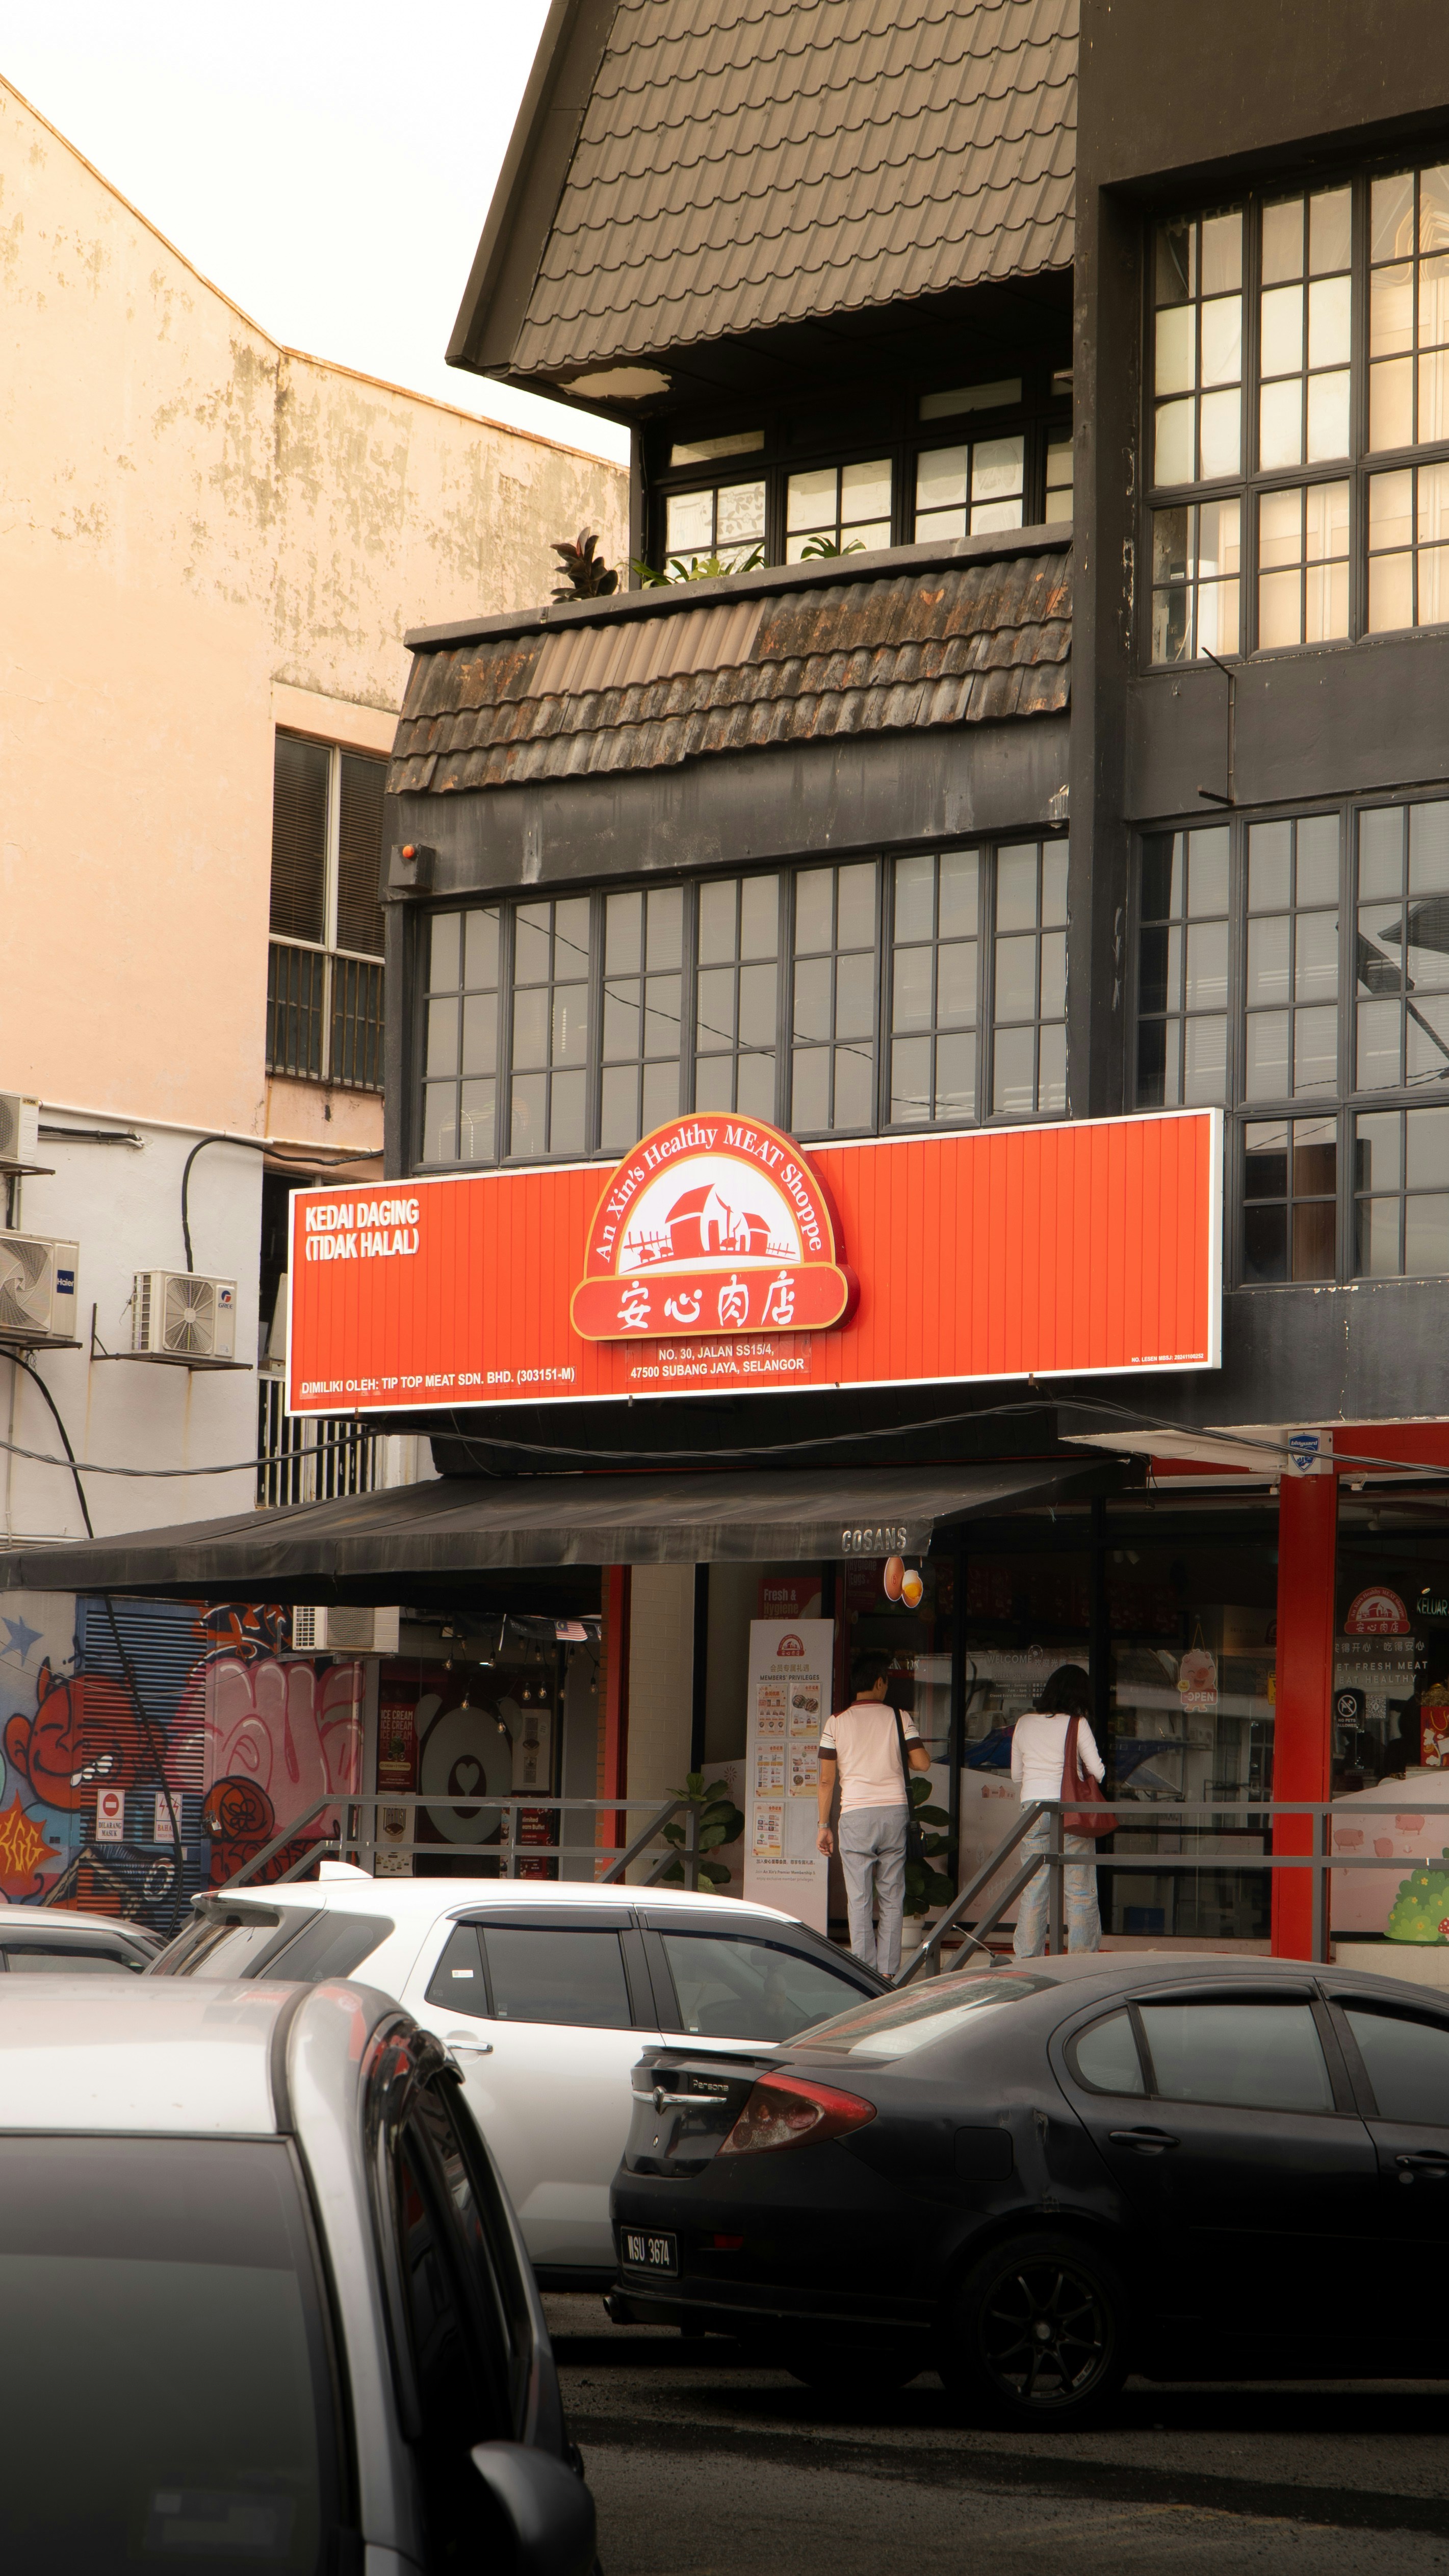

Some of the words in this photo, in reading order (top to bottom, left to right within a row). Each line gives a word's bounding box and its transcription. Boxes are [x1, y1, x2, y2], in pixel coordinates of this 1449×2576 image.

[596, 1225, 616, 1263] An
[607, 1166, 645, 1220] Xin's
[642, 1124, 718, 1170] Healthy
[723, 1125, 785, 1168] MEAT
[780, 1163, 822, 1251] Shoppe
[306, 1204, 354, 1232] KEDAI
[357, 1198, 420, 1228] DAGING
[306, 1233, 358, 1261] (TIDAK
[360, 1228, 420, 1258] HALAL)
[57, 1278, 74, 1287] Haier
[617, 1270, 795, 1331] 安心肉店
[659, 1349, 678, 1361] NO.
[680, 1347, 695, 1360] 30,
[697, 1345, 733, 1359] JALAN
[736, 1343, 774, 1357] SS15/4,
[631, 1366, 659, 1379] 47500
[662, 1363, 708, 1376] SUBANG
[710, 1361, 740, 1374] JAYA,
[743, 1358, 805, 1372] SELANGOR
[302, 1381, 343, 1394] DIMILIKI
[346, 1379, 379, 1391] OLEH:
[382, 1378, 398, 1389] TIP
[400, 1376, 423, 1388] TOP
[425, 1375, 456, 1387] MEAT
[458, 1373, 484, 1386] SDN.
[487, 1371, 514, 1384] BHD.
[516, 1367, 575, 1385] (303151-M)
[842, 1527, 907, 1552] COSANS
[764, 1589, 789, 1601] Fresh
[791, 1590, 797, 1601] &
[1382, 1590, 1396, 1599] MEAT
[764, 1602, 799, 1616] Hygiene
[1416, 1597, 1448, 1616] KELUAR
[1356, 1621, 1399, 1633] 安心肉店
[987, 1654, 1032, 1664] WELCOME
[1336, 1663, 1350, 1671] ET
[1355, 1662, 1392, 1671] FRESH
[1398, 1661, 1429, 1670] MEAT
[1339, 1676, 1359, 1685] EAT
[1365, 1674, 1417, 1684] HEALTHY
[381, 1710, 392, 1720] ICE
[392, 1710, 413, 1720] CREAM
[381, 1720, 391, 1730] ICE
[392, 1720, 412, 1730] CREAM
[380, 1729, 390, 1740] ICE
[693, 2079, 730, 2092] Persona
[628, 2234, 645, 2262] WSU
[648, 2238, 670, 2266] 3674
